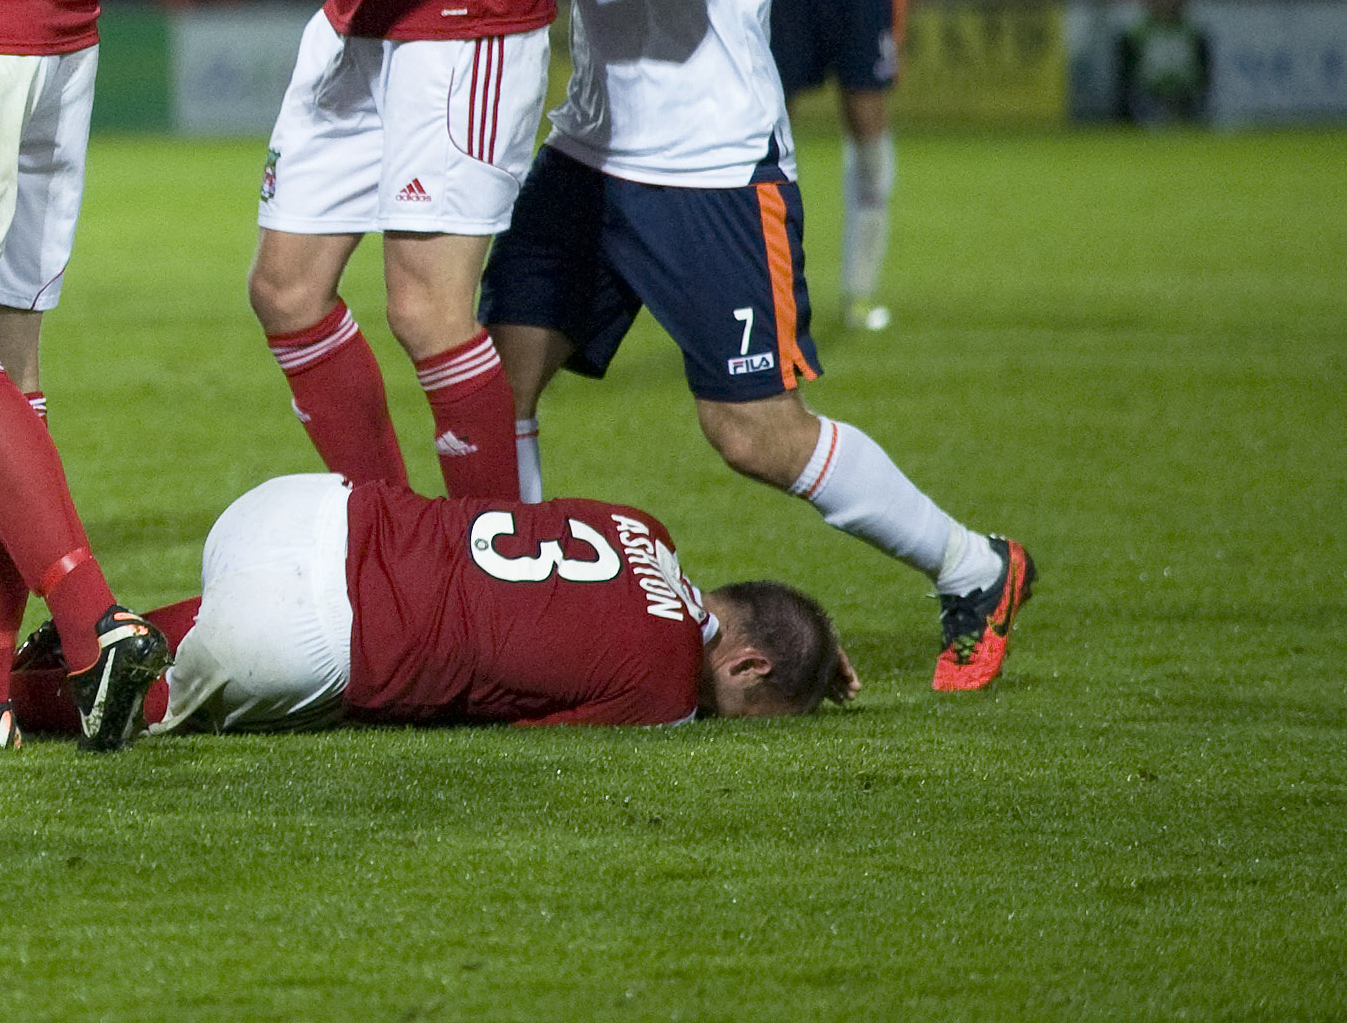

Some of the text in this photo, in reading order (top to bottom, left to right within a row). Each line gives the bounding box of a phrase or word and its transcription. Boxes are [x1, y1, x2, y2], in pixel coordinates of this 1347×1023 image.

[733, 307, 754, 356] 7
[733, 357, 771, 374] FILA
[469, 509, 622, 583] 3
[611, 514, 684, 622] ASHTON
